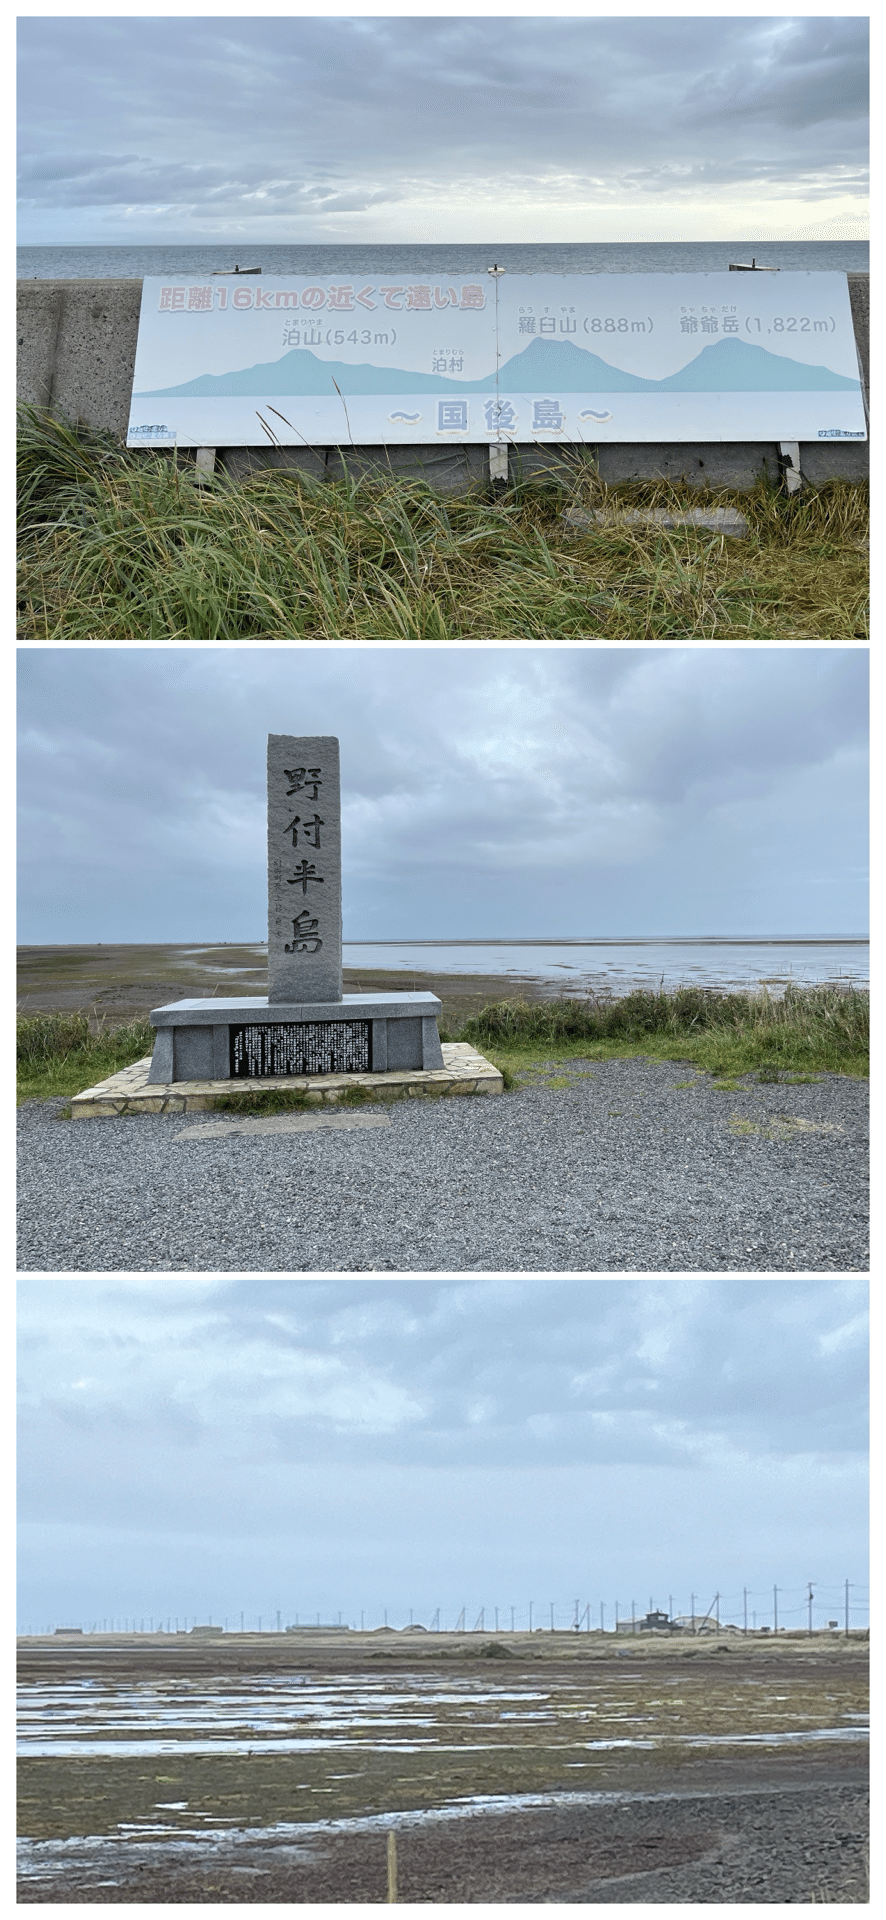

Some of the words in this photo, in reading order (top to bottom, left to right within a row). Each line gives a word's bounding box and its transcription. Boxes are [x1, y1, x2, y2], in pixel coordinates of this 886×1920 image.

[159, 285, 485, 310] 距離16kmの近くて遠い島
[284, 318, 324, 327] とまりやま
[431, 356, 465, 373] 泊村
[283, 767, 325, 955] 野付半島
